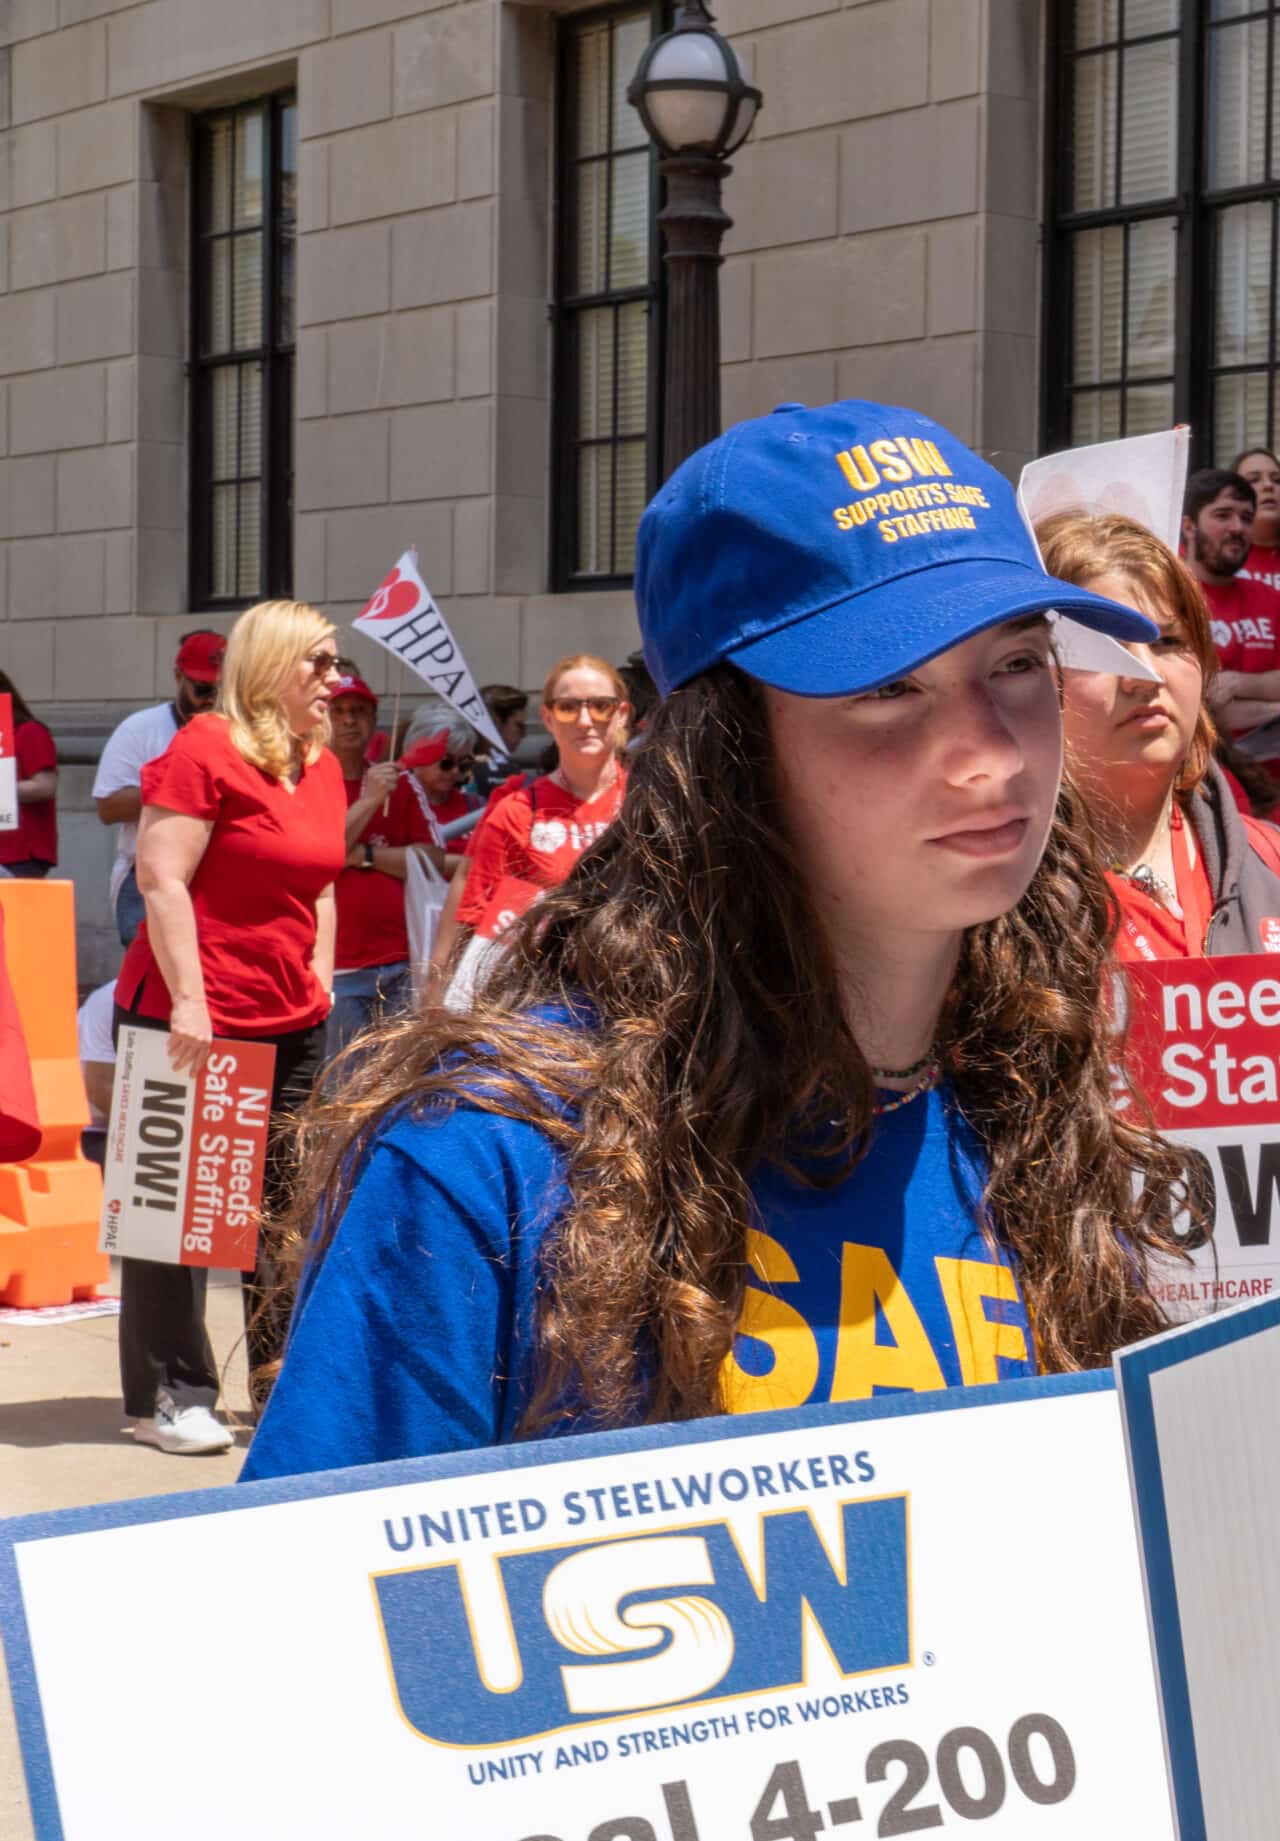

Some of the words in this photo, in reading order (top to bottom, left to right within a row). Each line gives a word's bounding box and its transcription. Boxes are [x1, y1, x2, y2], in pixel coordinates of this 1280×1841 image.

[833, 483, 948, 530] SUPPORTS
[946, 483, 991, 508] SAFE
[835, 437, 953, 491] USW
[878, 507, 976, 543] STAFFING
[380, 604, 484, 722] HPAE
[202, 1053, 238, 1123] Safe
[235, 1086, 268, 1128] NJ
[132, 1079, 187, 1212] NOW!
[183, 1132, 229, 1254] Staffing
[225, 1138, 256, 1228] needs
[104, 1215, 118, 1250] HPAE
[718, 1228, 1030, 1415] SAF
[383, 1499, 547, 1552] UNITED
[564, 1450, 876, 1527] STEELWORKERS
[368, 1491, 914, 1750] USW
[467, 1751, 545, 1787] UNITY
[555, 1740, 609, 1770] AND
[616, 1714, 740, 1757] STRENGTH
[746, 1704, 793, 1733] FOR
[796, 1683, 910, 1725] WORKERS
[749, 1713, 1078, 1841] 4-200
